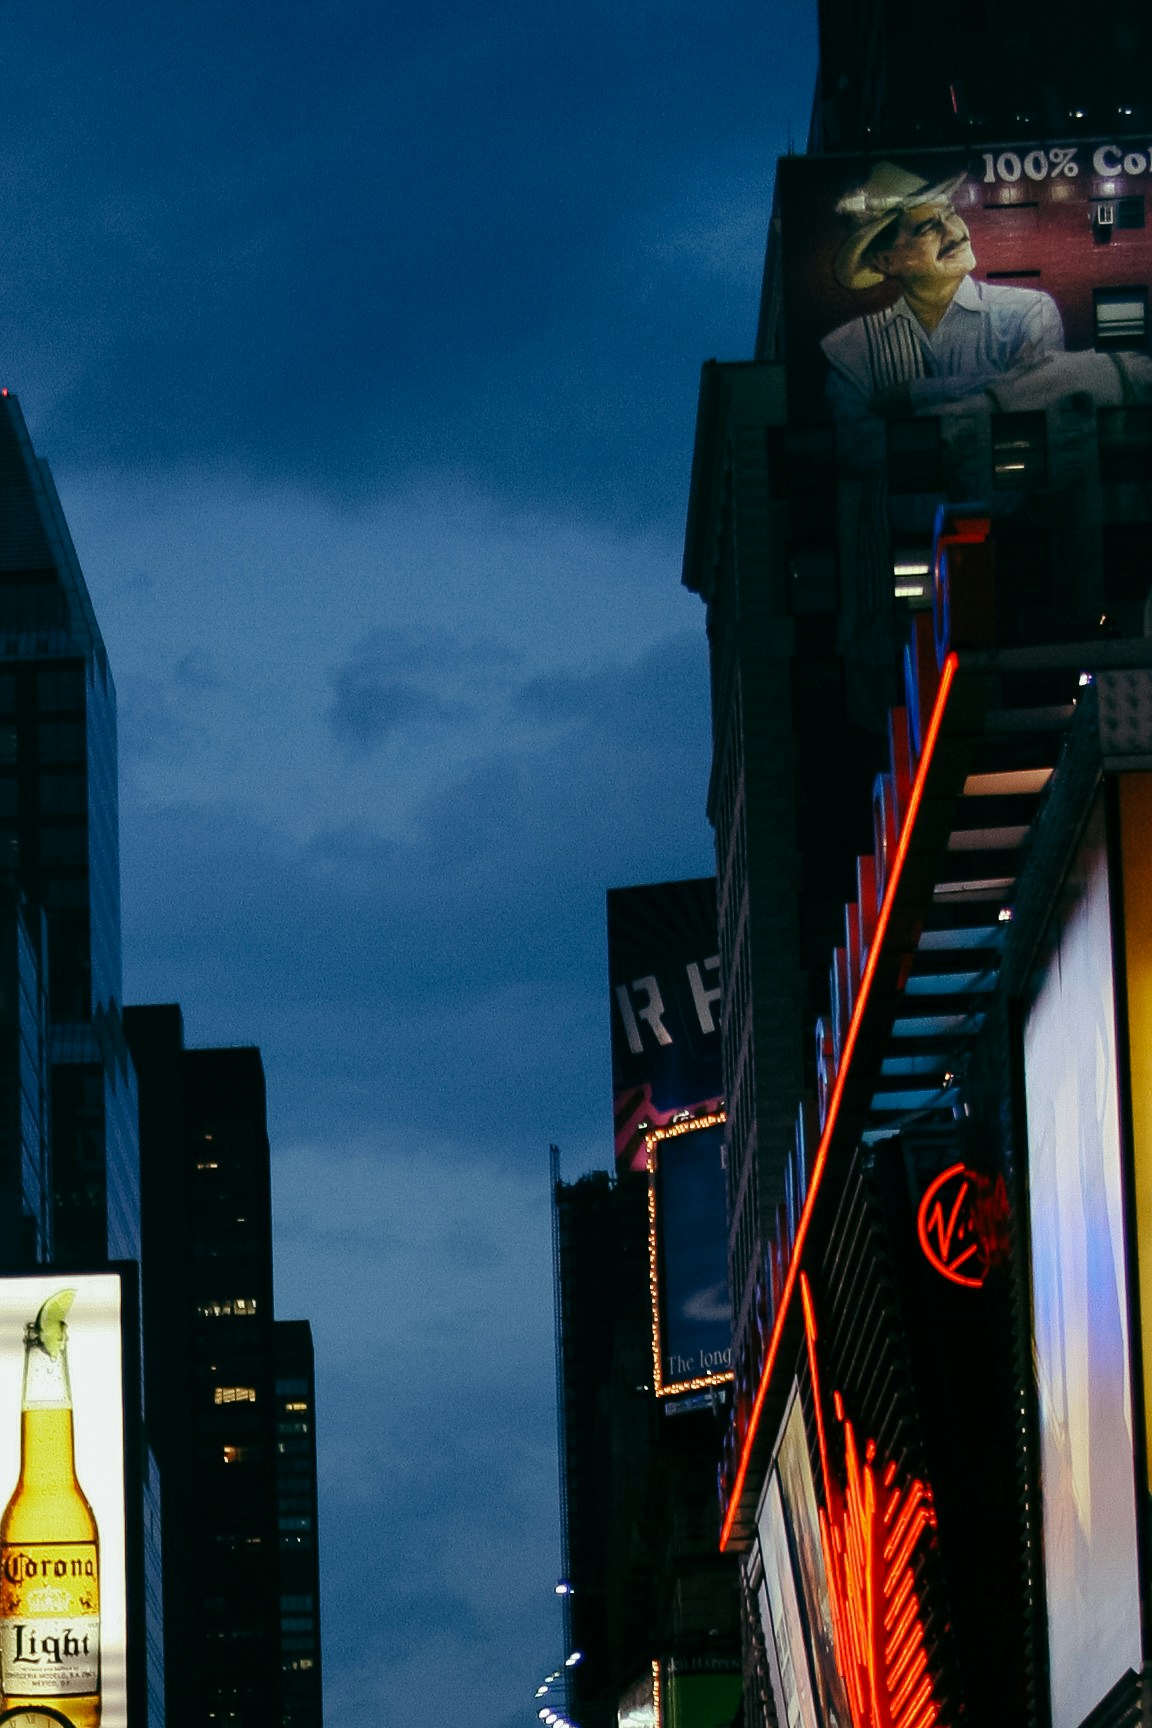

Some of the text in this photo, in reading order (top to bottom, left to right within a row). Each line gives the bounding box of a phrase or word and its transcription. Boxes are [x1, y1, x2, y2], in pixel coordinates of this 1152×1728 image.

[983, 150, 1079, 183] 100%
[667, 1353, 695, 1376] The
[4, 1553, 96, 1588] Corona
[13, 1624, 90, 1664] Light
